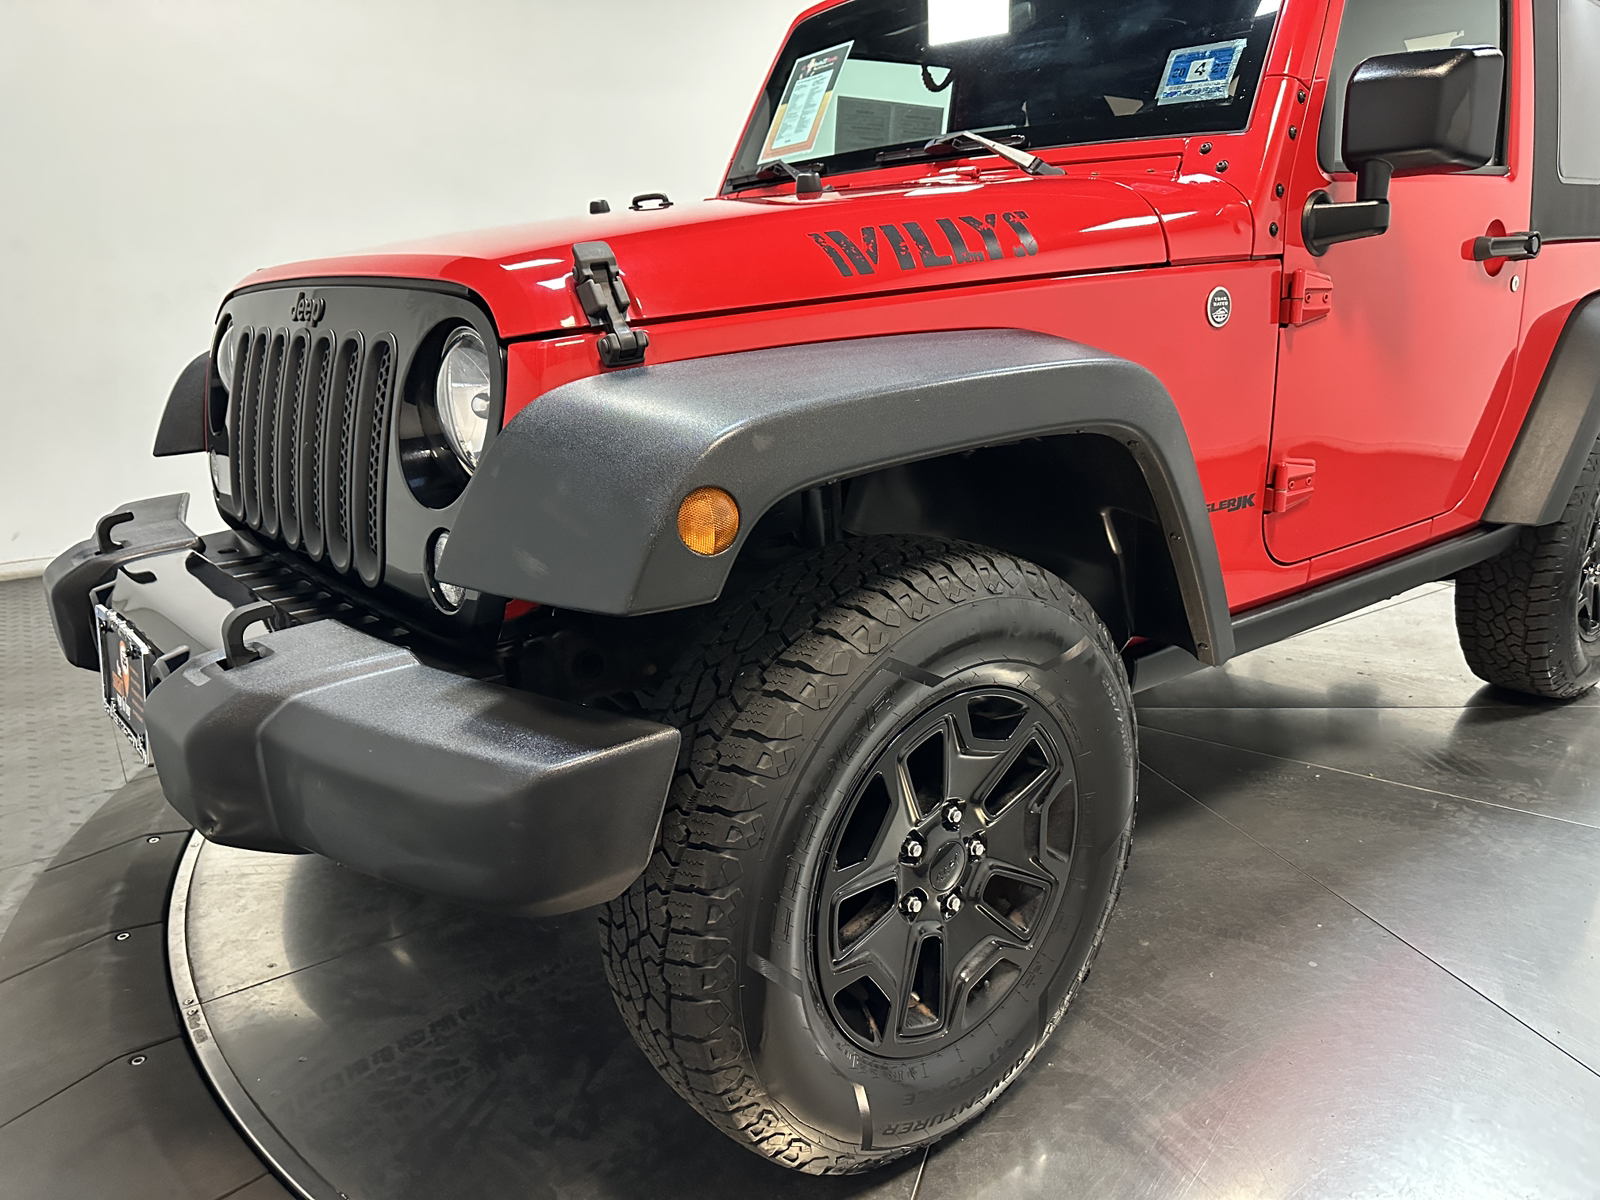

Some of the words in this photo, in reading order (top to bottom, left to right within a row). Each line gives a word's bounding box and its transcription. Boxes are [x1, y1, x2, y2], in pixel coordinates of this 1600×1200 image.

[1172, 67, 1186, 78] 20
[1194, 62, 1207, 76] 4
[807, 211, 1039, 277] WILLYS
[291, 292, 326, 328] Jeep
[880, 1044, 1031, 1137] ADVENTURER
